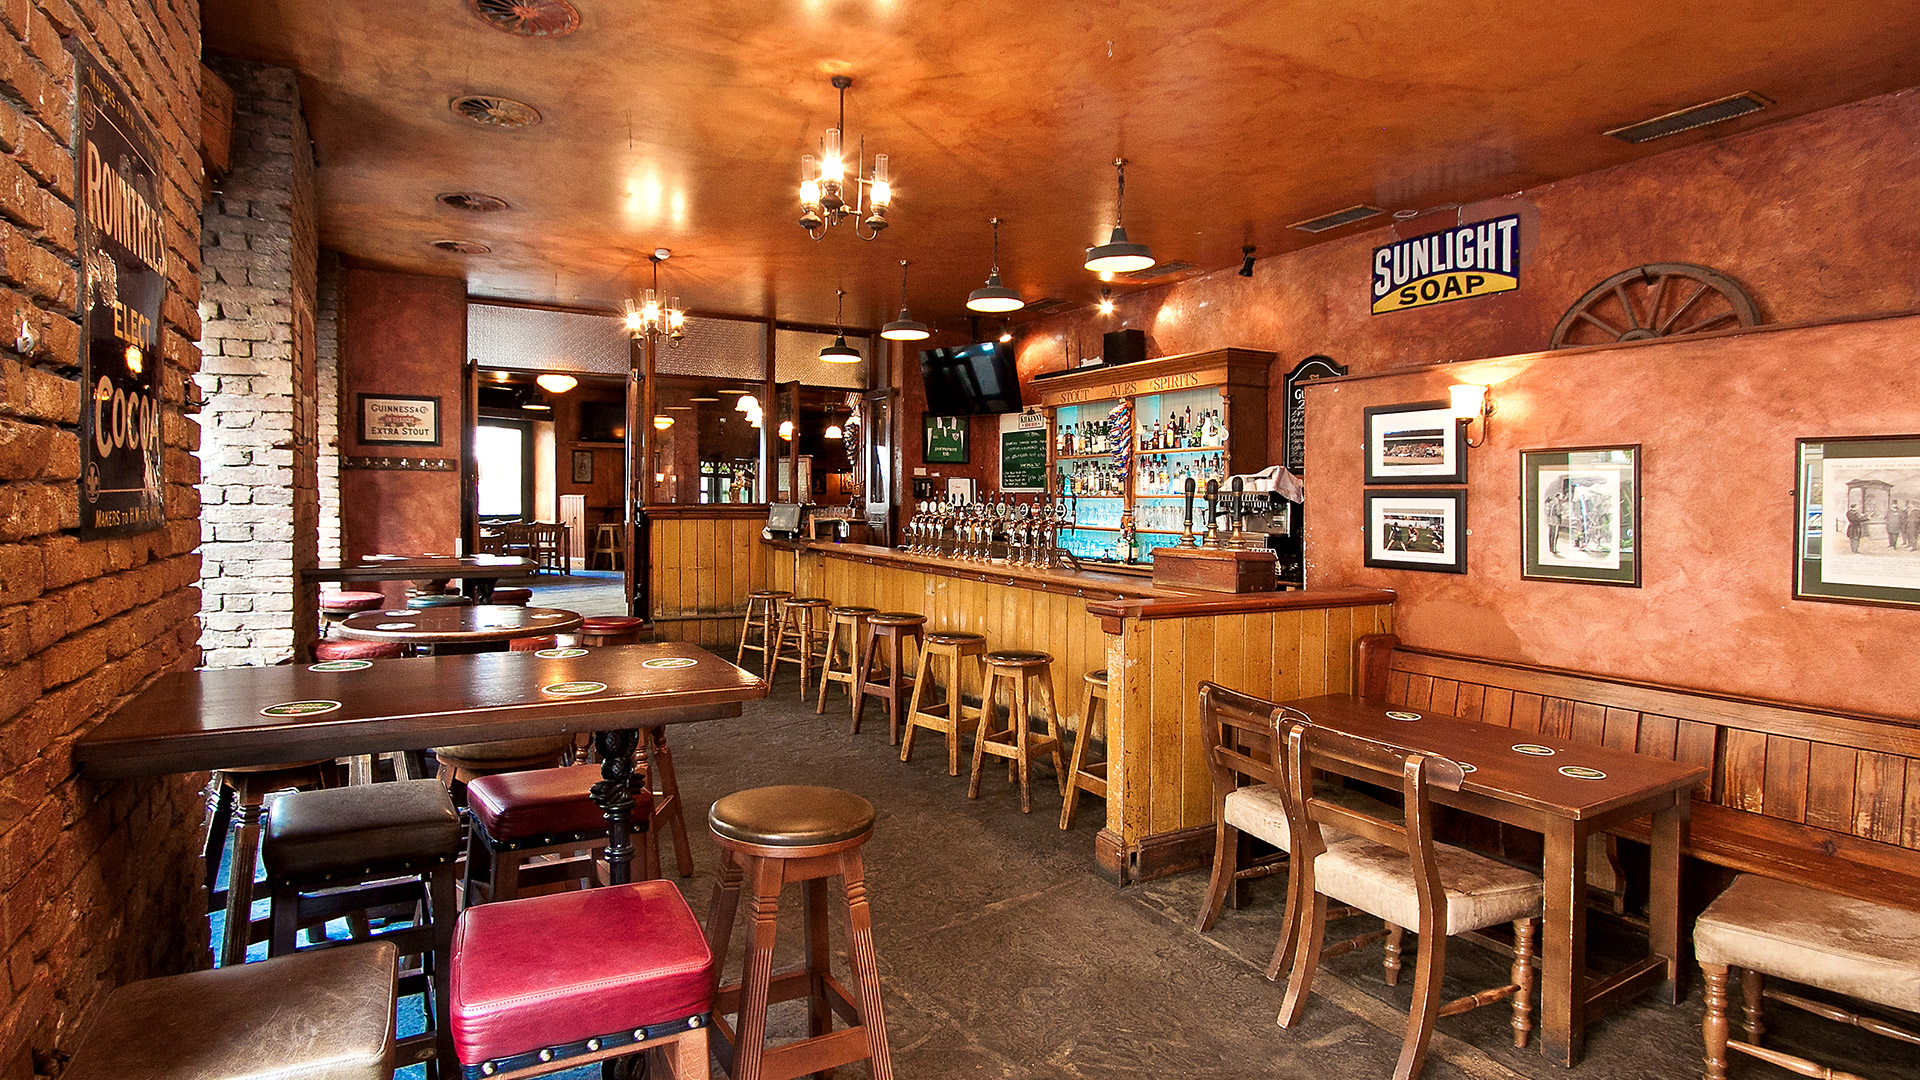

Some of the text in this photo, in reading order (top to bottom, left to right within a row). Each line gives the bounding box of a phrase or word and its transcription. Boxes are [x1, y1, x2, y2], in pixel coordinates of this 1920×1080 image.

[1374, 218, 1518, 296] SUNLIGHT
[1399, 275, 1485, 305] SOAP
[113, 300, 151, 352] ELECT
[1061, 372, 1199, 403] STOUT ALES SPIRITS
[95, 375, 160, 458] COCOA
[370, 404, 415, 413] GUINNESS
[371, 427, 430, 436] EXTRA STOUT
[95, 510, 120, 528] MAKERS
